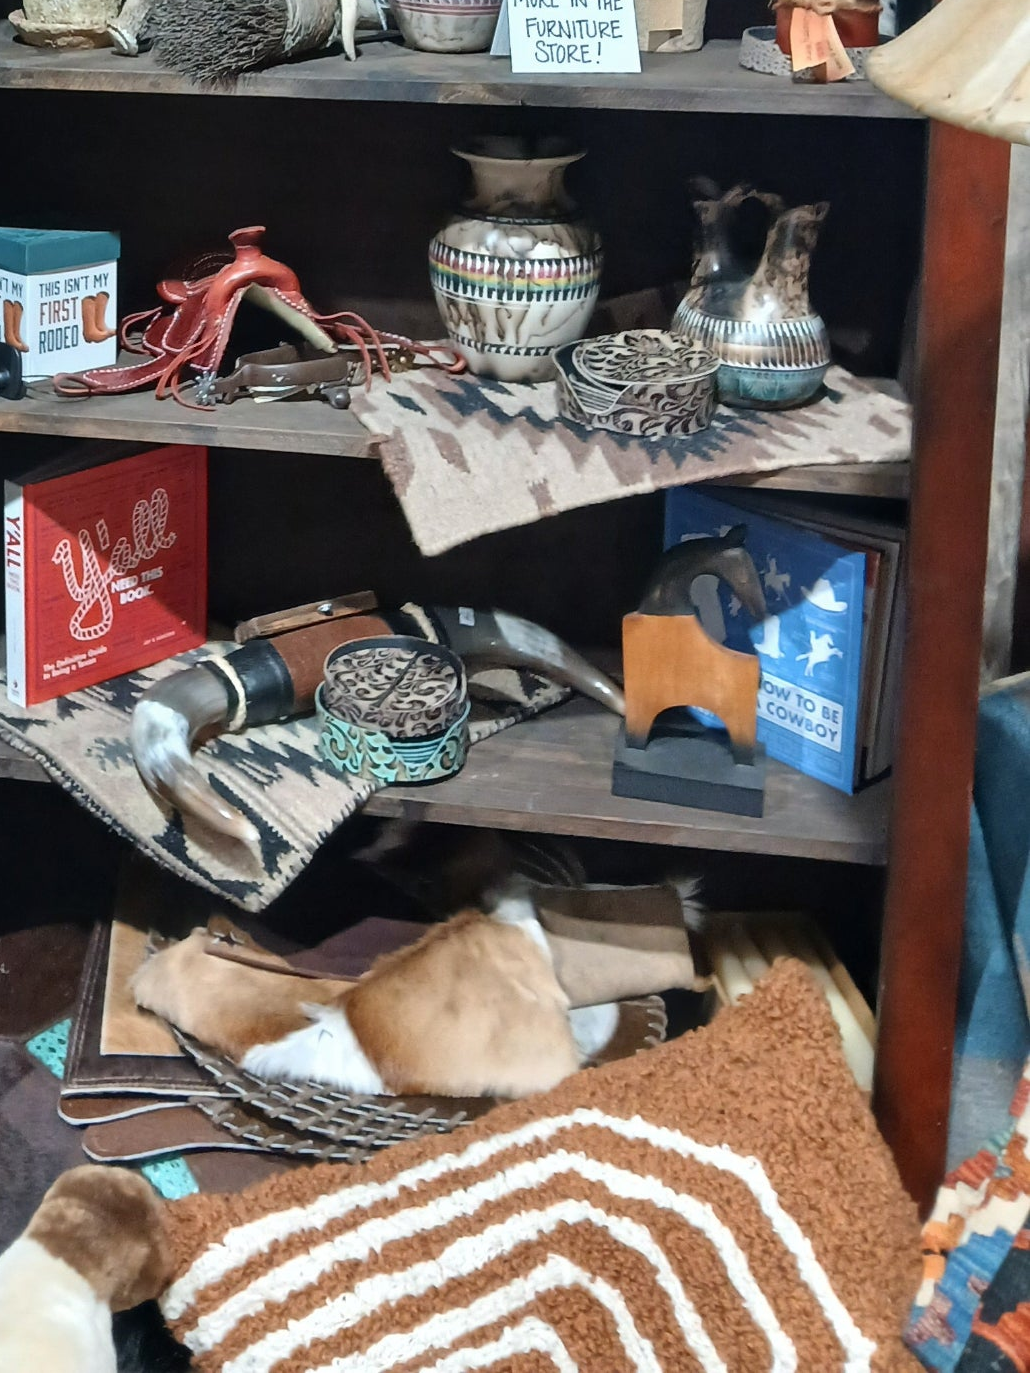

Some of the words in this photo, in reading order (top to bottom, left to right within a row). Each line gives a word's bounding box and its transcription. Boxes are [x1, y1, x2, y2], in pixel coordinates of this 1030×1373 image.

[525, 17, 623, 39] FURNITURE
[11, 281, 24, 299] MY
[39, 281, 60, 298] THIS
[64, 275, 90, 294] ISN'T
[93, 273, 109, 288] MY
[40, 297, 79, 326] FIRST
[39, 325, 79, 354] RODEO
[6, 517, 21, 567] Y'ALL
[761, 680, 790, 701] OW
[796, 693, 816, 713] TO
[821, 706, 839, 724] BE
[766, 701, 838, 742] COWBOY
